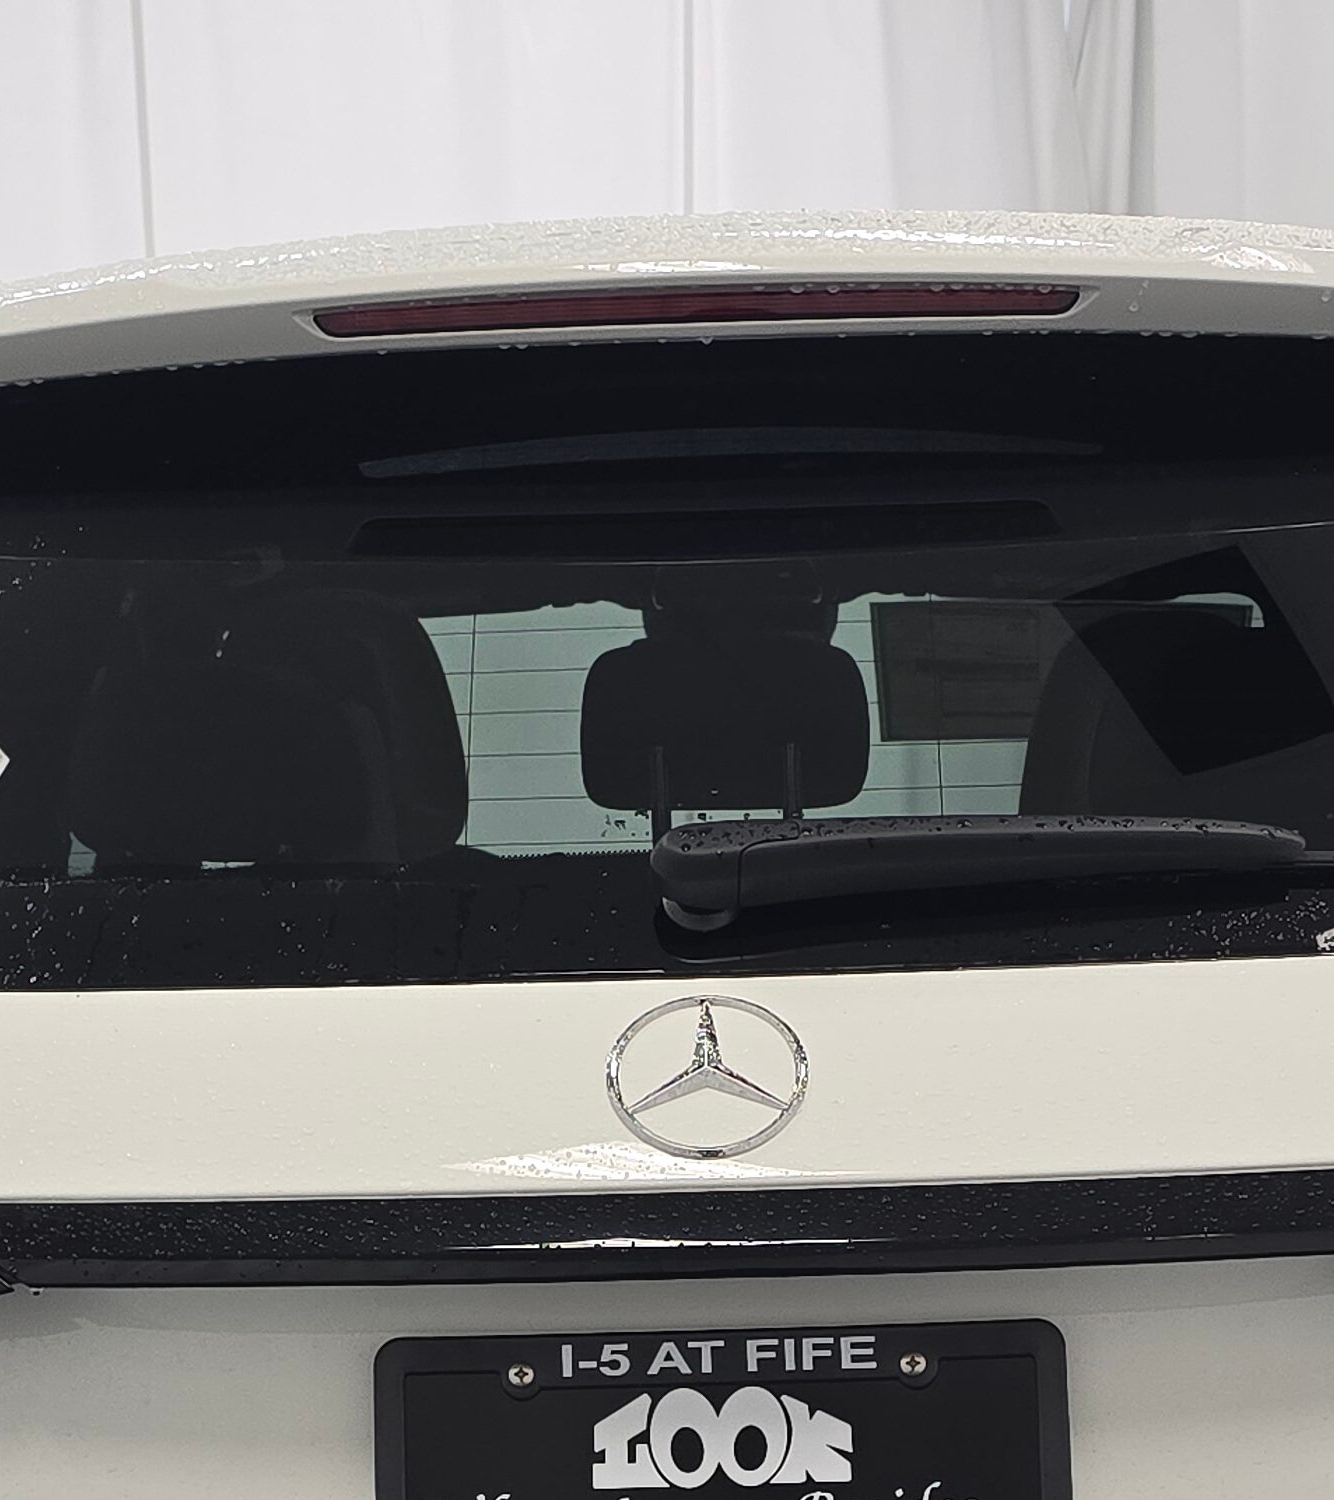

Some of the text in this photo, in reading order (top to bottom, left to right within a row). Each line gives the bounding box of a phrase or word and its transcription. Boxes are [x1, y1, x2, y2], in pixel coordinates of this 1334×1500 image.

[560, 1335, 879, 1379] I-5 AT FIFE
[592, 1386, 855, 1490] LOOK
